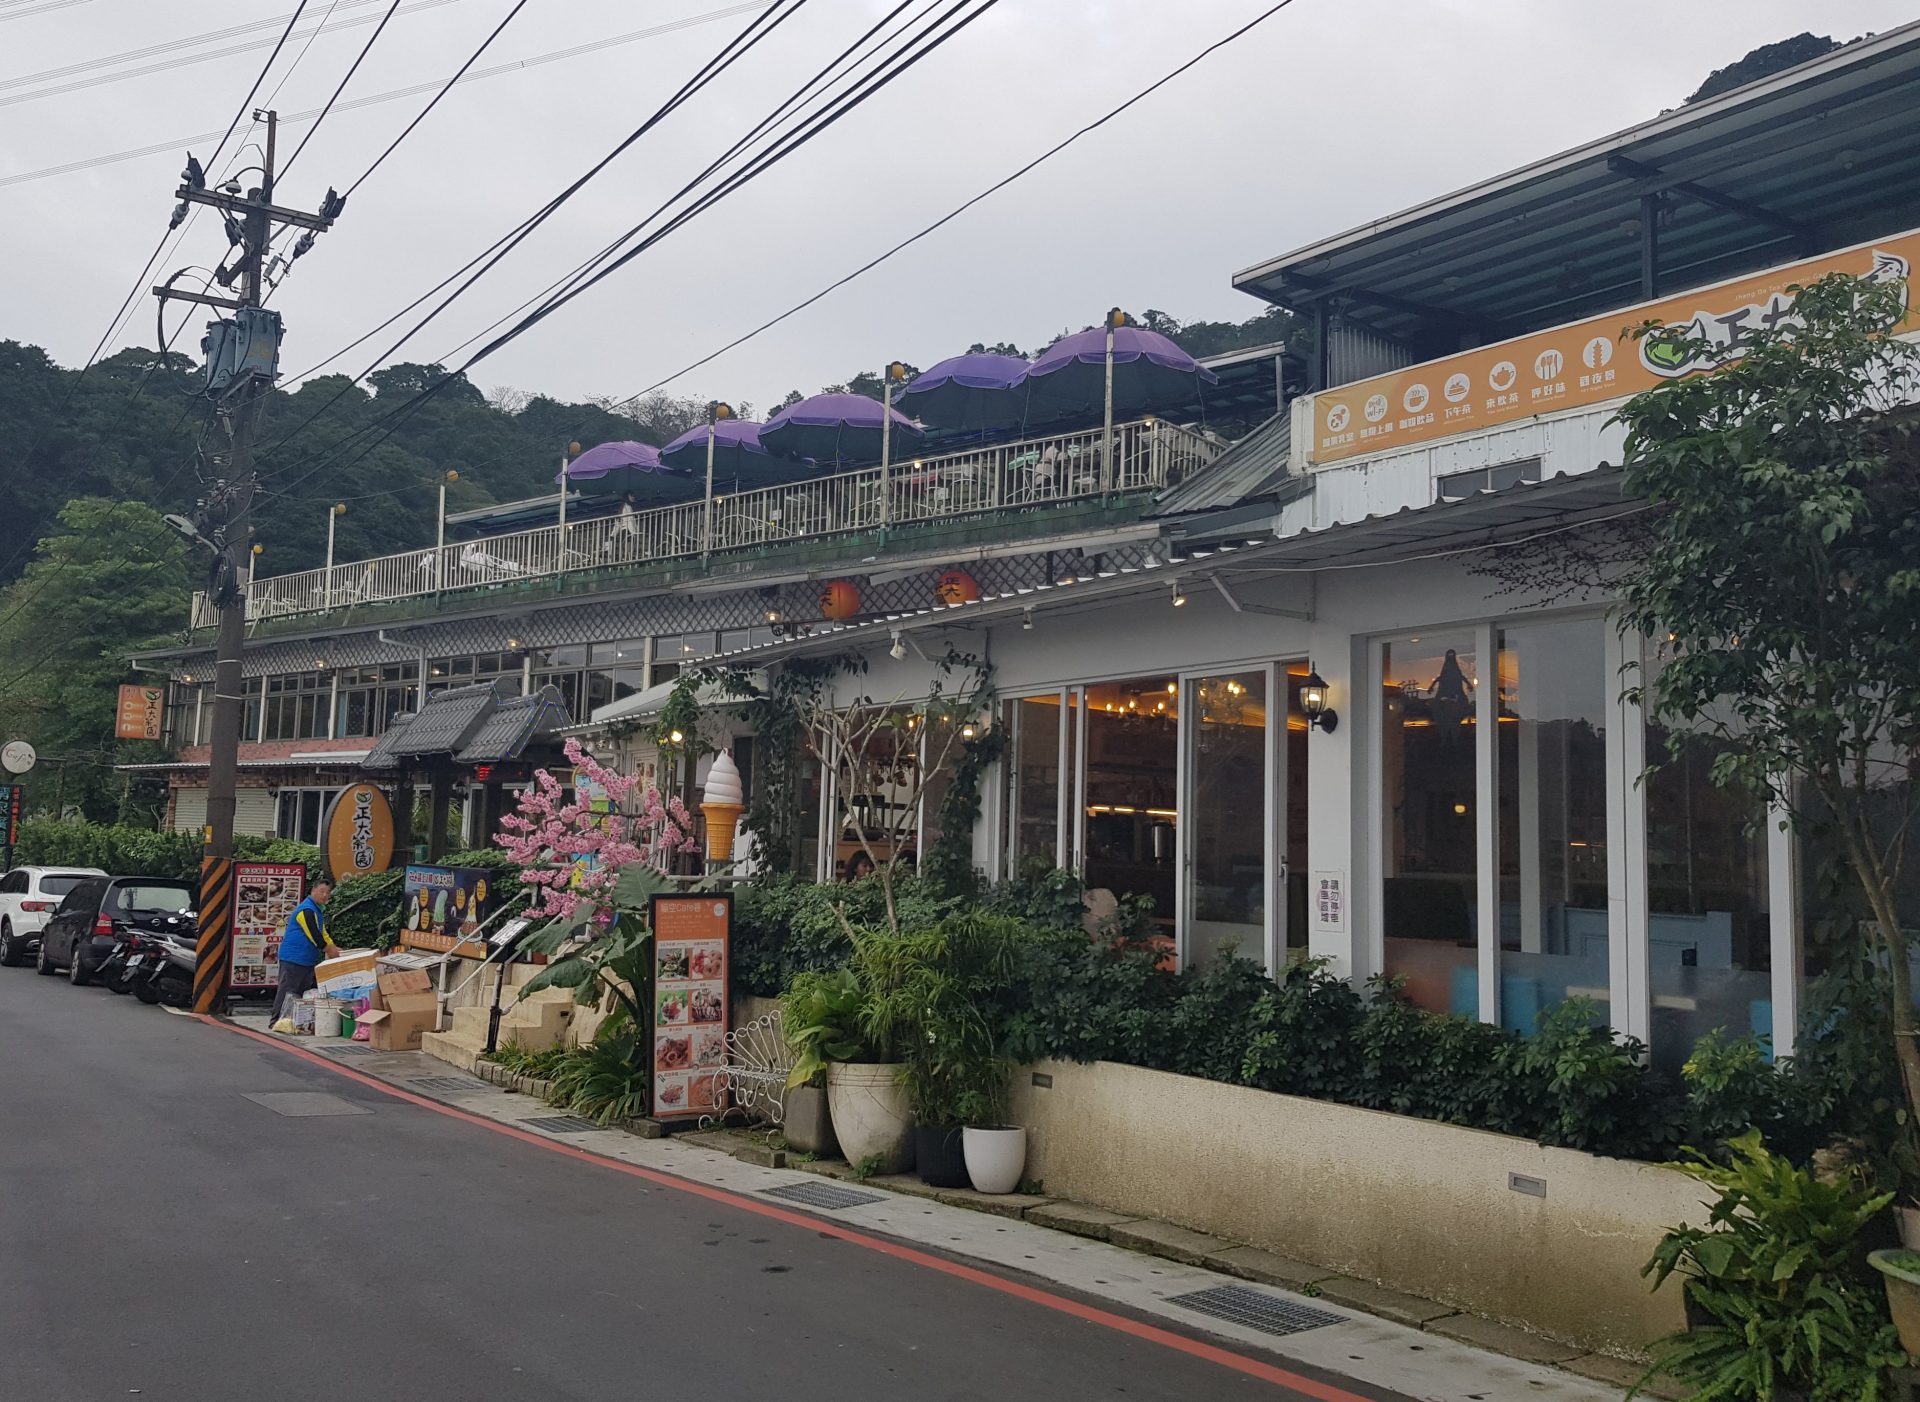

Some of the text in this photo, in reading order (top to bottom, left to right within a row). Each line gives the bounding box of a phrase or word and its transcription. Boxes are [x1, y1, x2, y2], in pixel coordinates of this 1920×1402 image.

[1444, 404, 1472, 419] 下午茶
[353, 805, 373, 868] 正大茶園
[1330, 879, 1339, 923] 請勿停車
